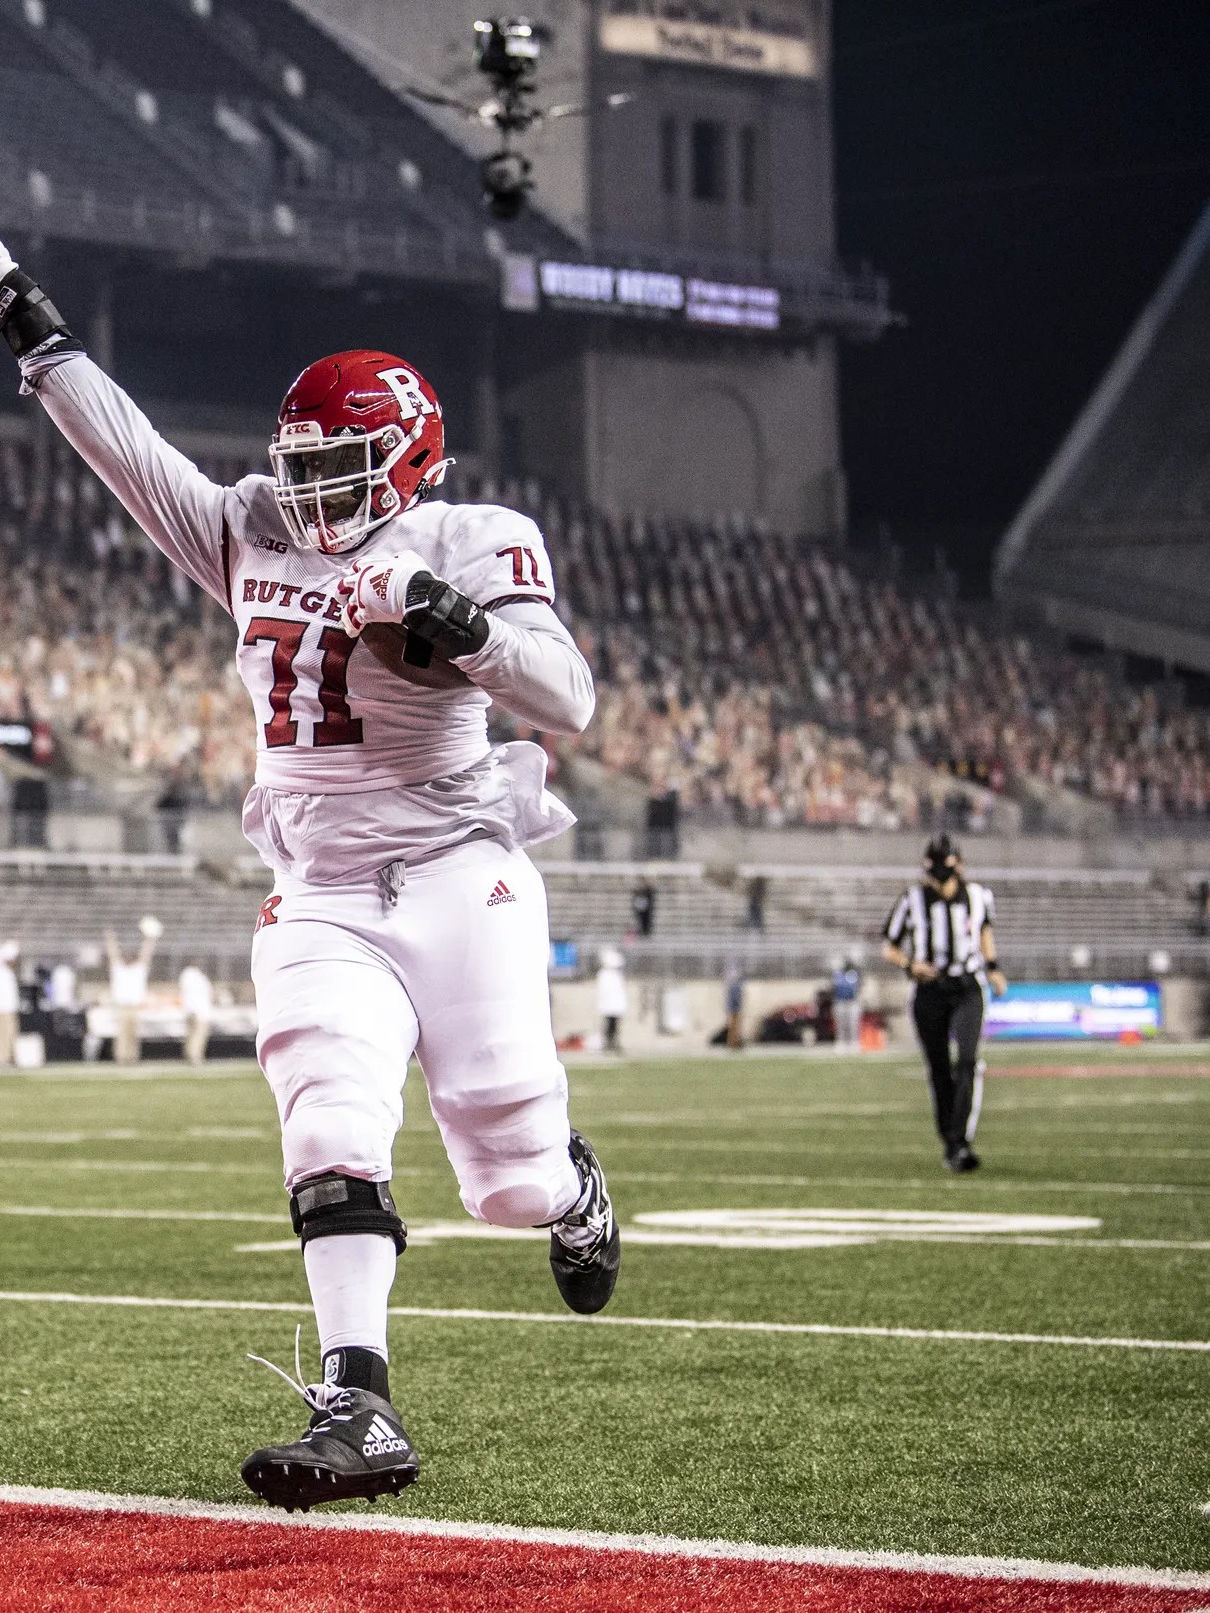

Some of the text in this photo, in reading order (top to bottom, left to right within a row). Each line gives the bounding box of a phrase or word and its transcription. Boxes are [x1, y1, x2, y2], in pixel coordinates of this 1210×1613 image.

[375, 367, 435, 421] R
[380, 567, 394, 601] adidas
[495, 546, 547, 588] 71
[243, 579, 344, 621] RUTGE
[243, 616, 364, 748] 71
[486, 893, 517, 907] adidas
[362, 1437, 409, 1457] adidas
